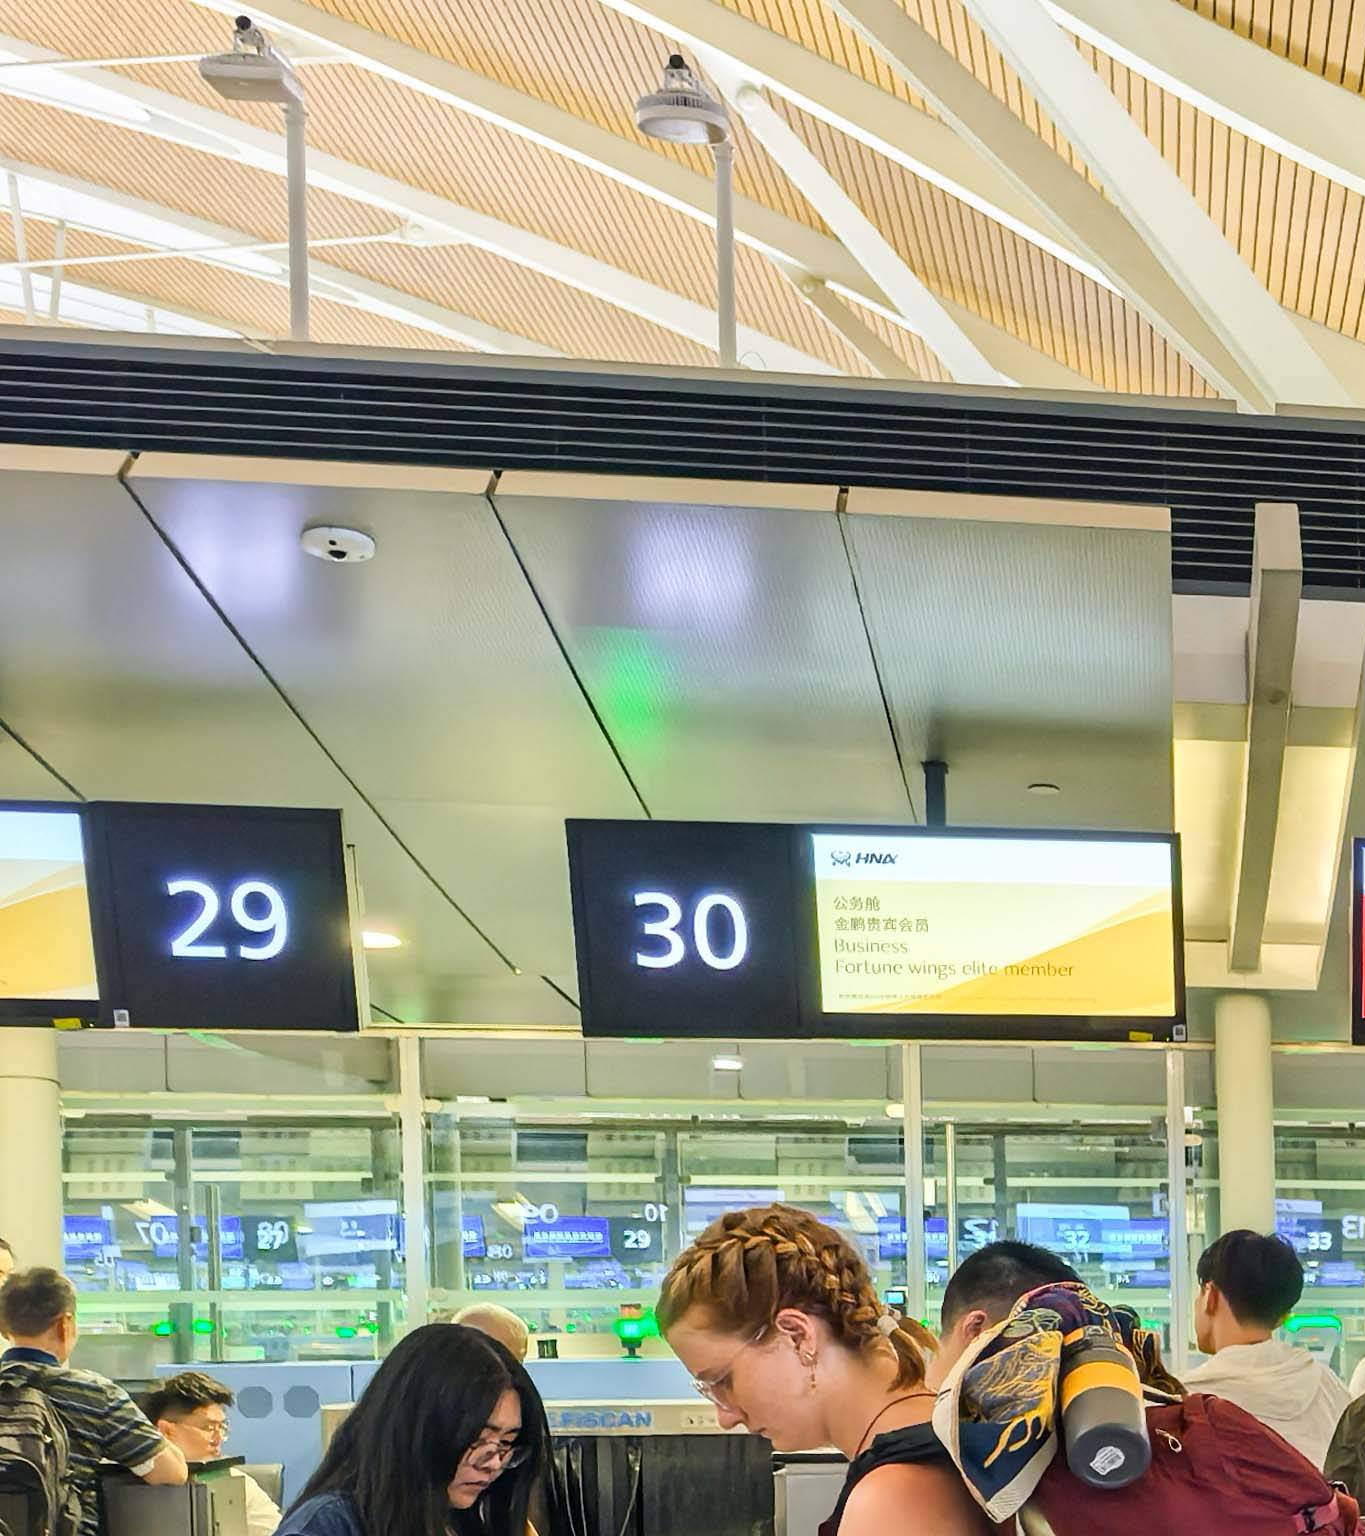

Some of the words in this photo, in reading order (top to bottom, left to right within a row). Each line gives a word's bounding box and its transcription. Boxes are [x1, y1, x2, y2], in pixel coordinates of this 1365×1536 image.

[833, 895, 881, 912] 公务舱
[167, 880, 288, 961] 29
[632, 891, 748, 970] 30
[834, 938, 908, 955] Business
[835, 958, 904, 976] Fortune
[908, 960, 957, 979] wings
[963, 960, 999, 977] elite
[1005, 962, 1075, 978] member
[623, 1229, 651, 1249] 29
[1307, 1232, 1332, 1251] 33
